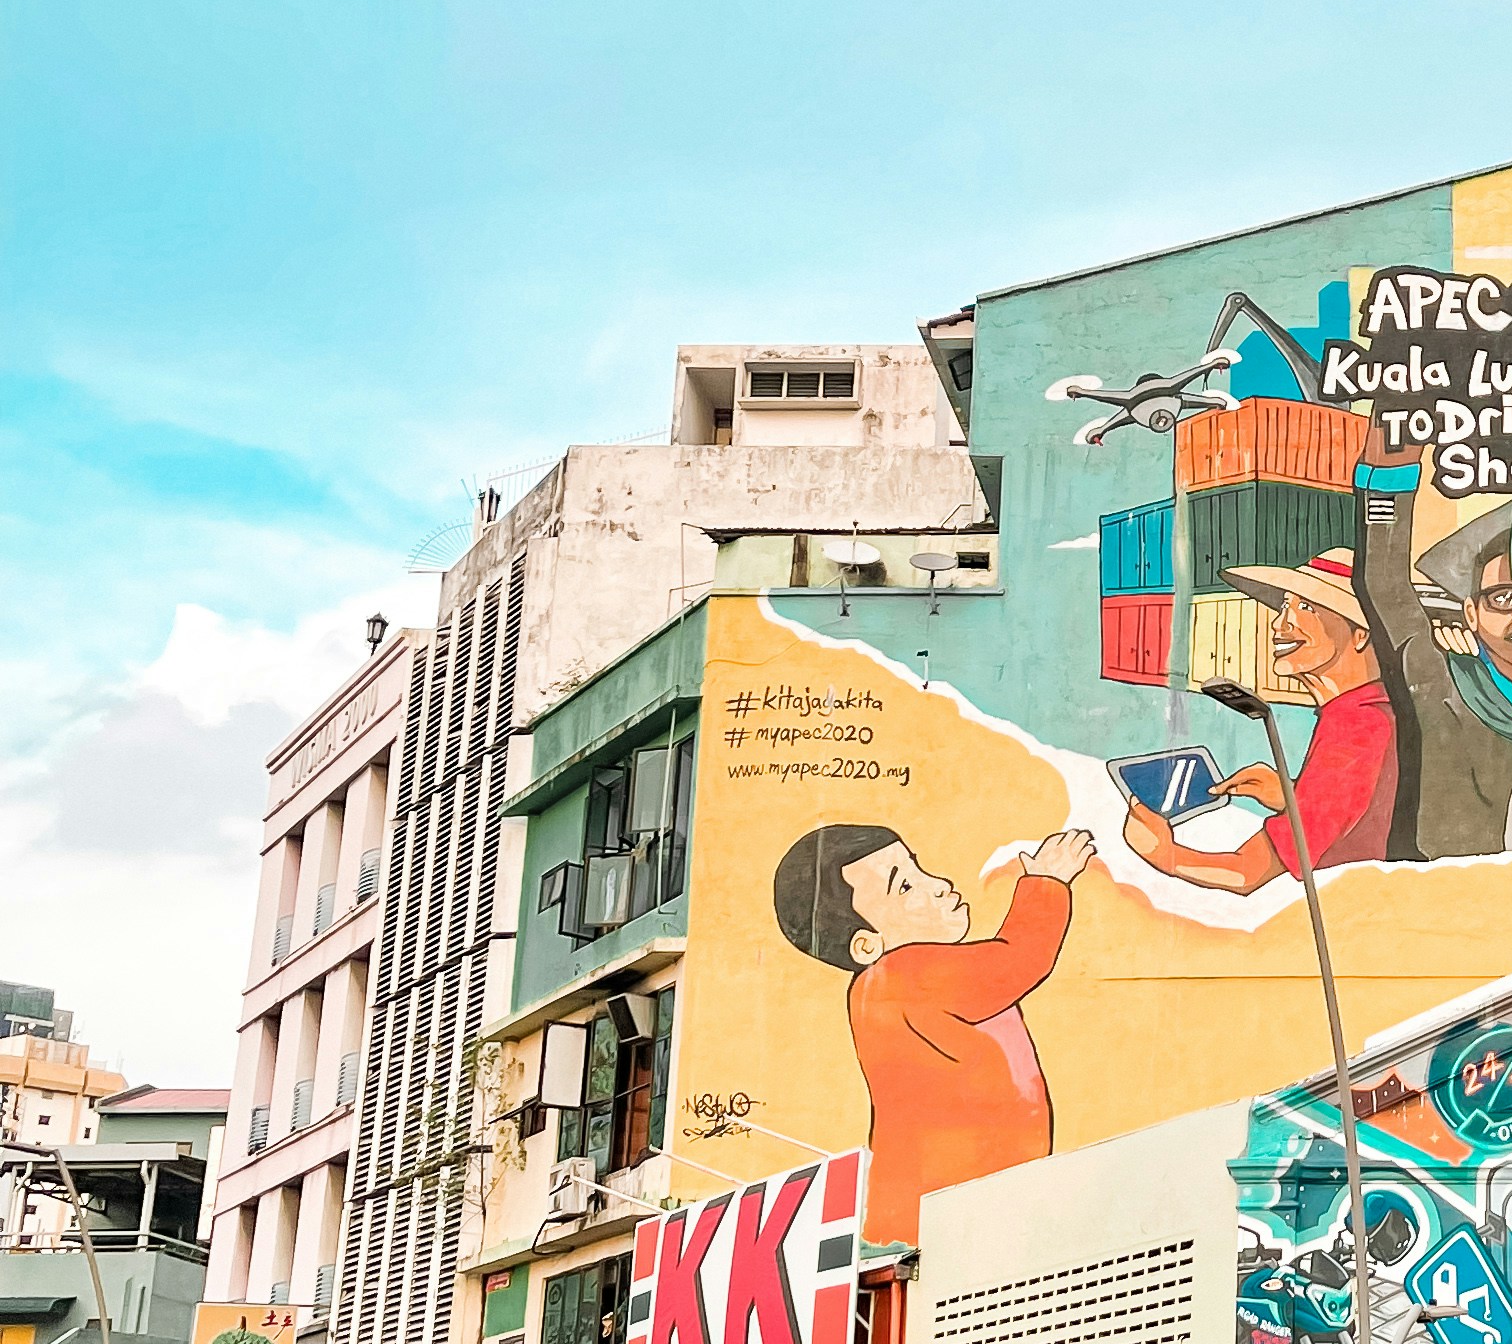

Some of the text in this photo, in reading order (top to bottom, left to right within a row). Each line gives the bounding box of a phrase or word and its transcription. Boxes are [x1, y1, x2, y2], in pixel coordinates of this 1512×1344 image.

[1367, 274, 1512, 332] APEC
[1322, 345, 1450, 395] Kuala
[728, 757, 910, 787] www.myapec2020.my
[1237, 1306, 1259, 1324] ROAD
